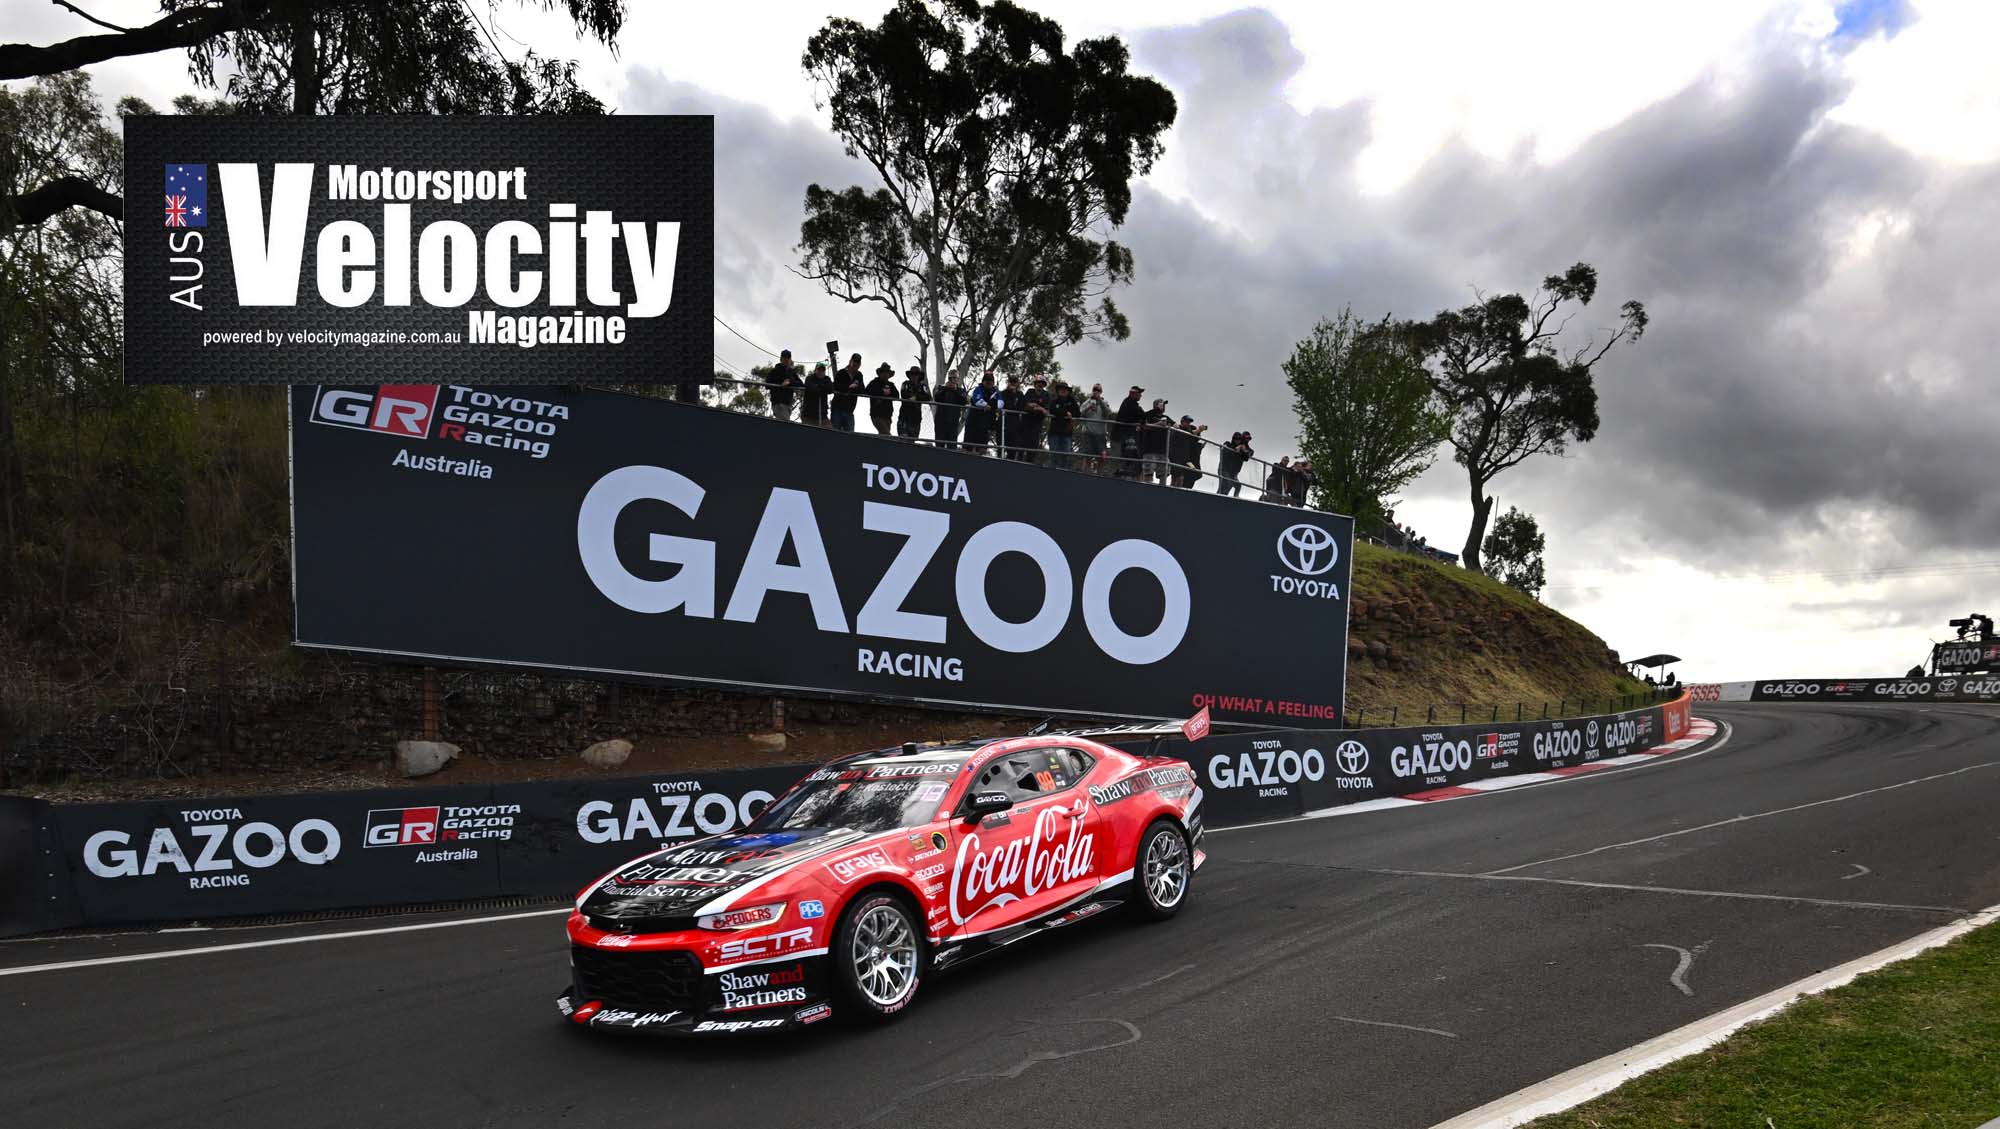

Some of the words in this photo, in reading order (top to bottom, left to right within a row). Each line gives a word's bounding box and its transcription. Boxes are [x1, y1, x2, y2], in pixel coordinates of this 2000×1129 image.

[319, 390, 429, 434] GR
[449, 385, 569, 420] TOYOTA
[443, 405, 556, 436] GAZOO
[439, 423, 550, 459] Racing
[392, 449, 493, 479] Australia
[862, 462, 971, 503] TOYOTA
[577, 465, 1191, 664] GAZOO
[1270, 575, 1340, 600] TOYOTA
[857, 649, 963, 682] RACING
[1941, 648, 1981, 666] GAZOO
[1762, 684, 1820, 694] GAZOO
[1874, 682, 1931, 695] GAZOO
[1962, 681, 2000, 694] GAZO
[1192, 693, 1216, 708] OH
[1219, 696, 1262, 712] WHAT
[1265, 700, 1275, 714] A
[1278, 702, 1335, 719] FEELING
[1422, 733, 1444, 742] TOYOTA
[1605, 720, 1636, 749] GAZOO
[1252, 740, 1281, 750] TOYOTA
[1478, 744, 1497, 757] GR
[1534, 729, 1581, 760] GAZOO
[1391, 740, 1472, 778] GAZOO
[868, 763, 960, 778] Partners
[1208, 749, 1325, 789] GAZOO
[653, 781, 701, 793] TOYOTA
[1036, 770, 1057, 792] 99
[1336, 777, 1374, 789] TOYOTA
[1426, 775, 1447, 785] RACING
[976, 795, 1007, 803] DAYCO
[1259, 788, 1288, 798] RACING
[181, 808, 243, 822] TOYOTA
[444, 804, 521, 818] TOYOTA
[443, 816, 514, 829] GAZOO
[368, 822, 434, 845] GR
[441, 829, 512, 841] Racing
[83, 818, 341, 878] GAZOO
[415, 848, 478, 863] Australia
[915, 848, 942, 861] DUNLO
[834, 852, 885, 877] grays
[190, 875, 250, 889] RACING
[724, 908, 771, 925] PEDDERS
[720, 926, 813, 959] SCTR
[723, 986, 806, 1009] Partners
[591, 1008, 637, 1027] Pizza
[633, 1010, 684, 1028] Hut
